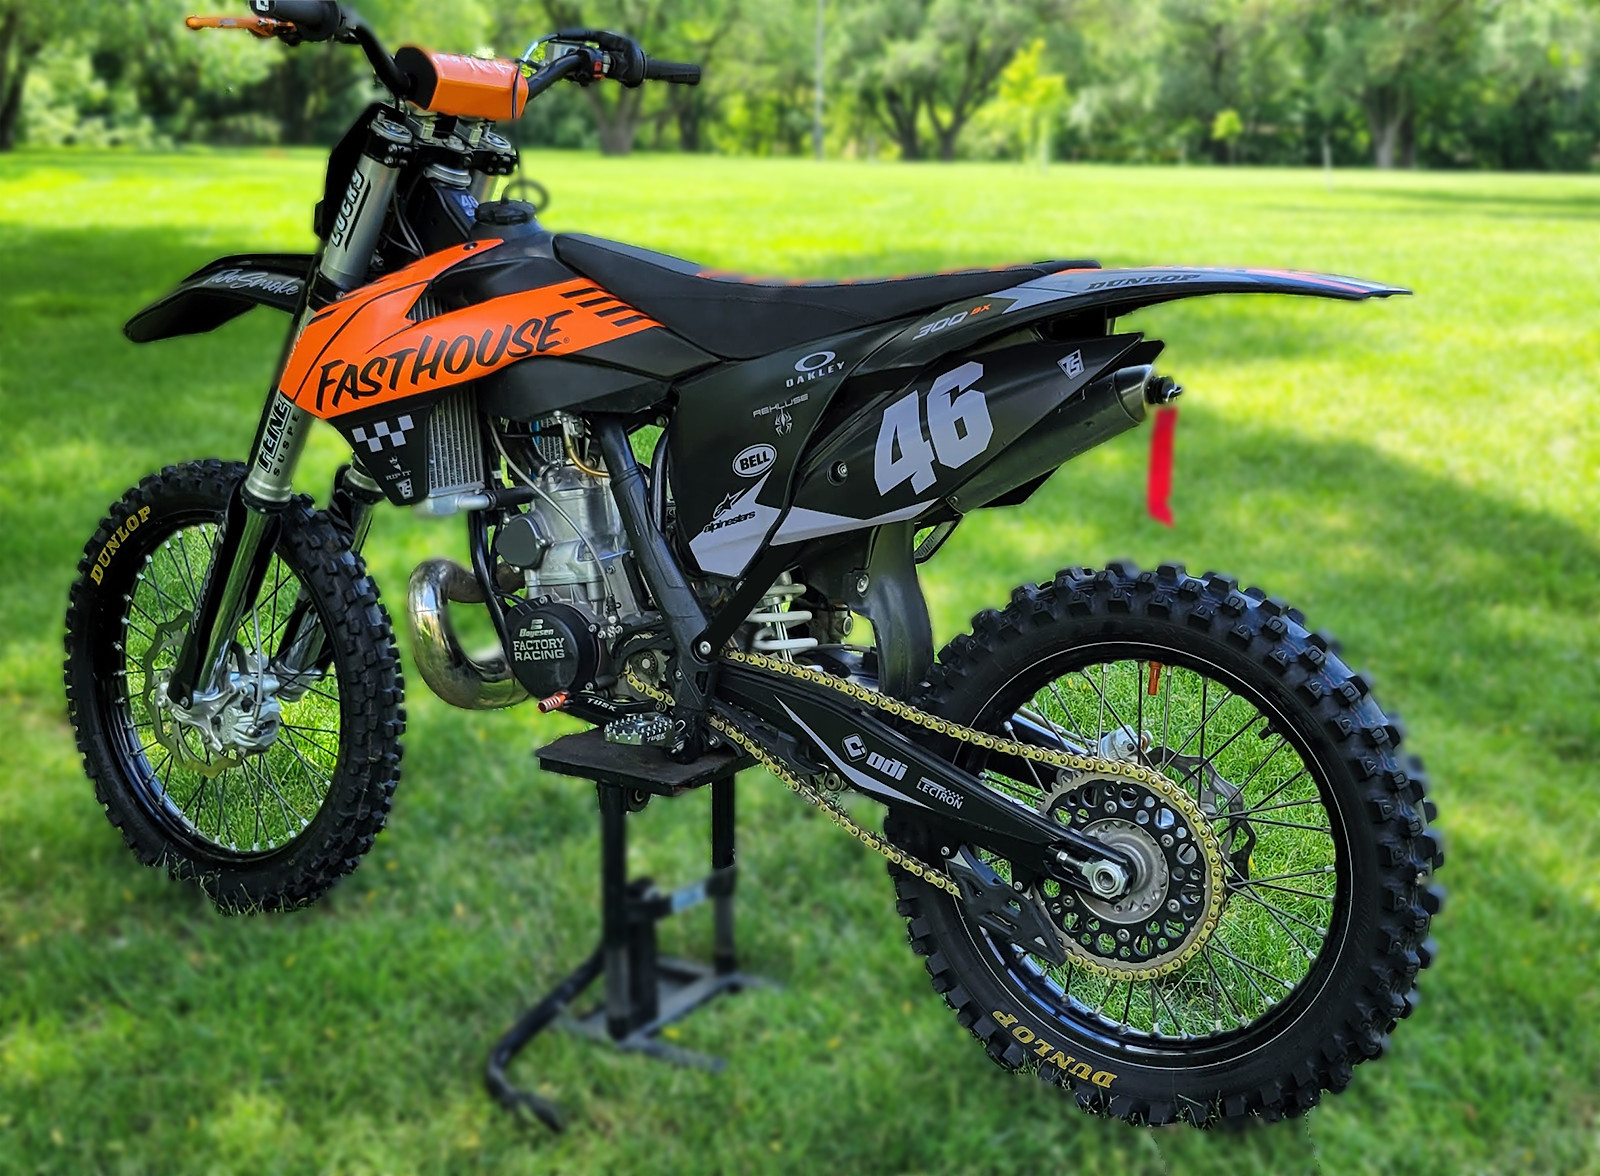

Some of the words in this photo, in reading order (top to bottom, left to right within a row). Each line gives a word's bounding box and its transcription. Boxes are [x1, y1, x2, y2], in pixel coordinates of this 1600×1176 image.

[331, 167, 365, 248] LUCKY
[1084, 274, 1200, 291] DUNLOP
[912, 311, 968, 340] 300
[316, 309, 574, 412] FASTHOUSE
[785, 361, 845, 388] OAKLEY
[874, 361, 994, 497] 46
[739, 450, 771, 471] BELL
[703, 511, 756, 533] alpinestars
[90, 505, 151, 586] DUNLOP
[513, 637, 565, 651] FACTORY
[519, 628, 554, 638] Boyesen
[514, 648, 566, 662] RACING
[587, 697, 617, 712] TUSK
[866, 752, 908, 781] odi
[916, 777, 964, 810] LECTRON
[992, 1010, 1118, 1089] DUNLOP
